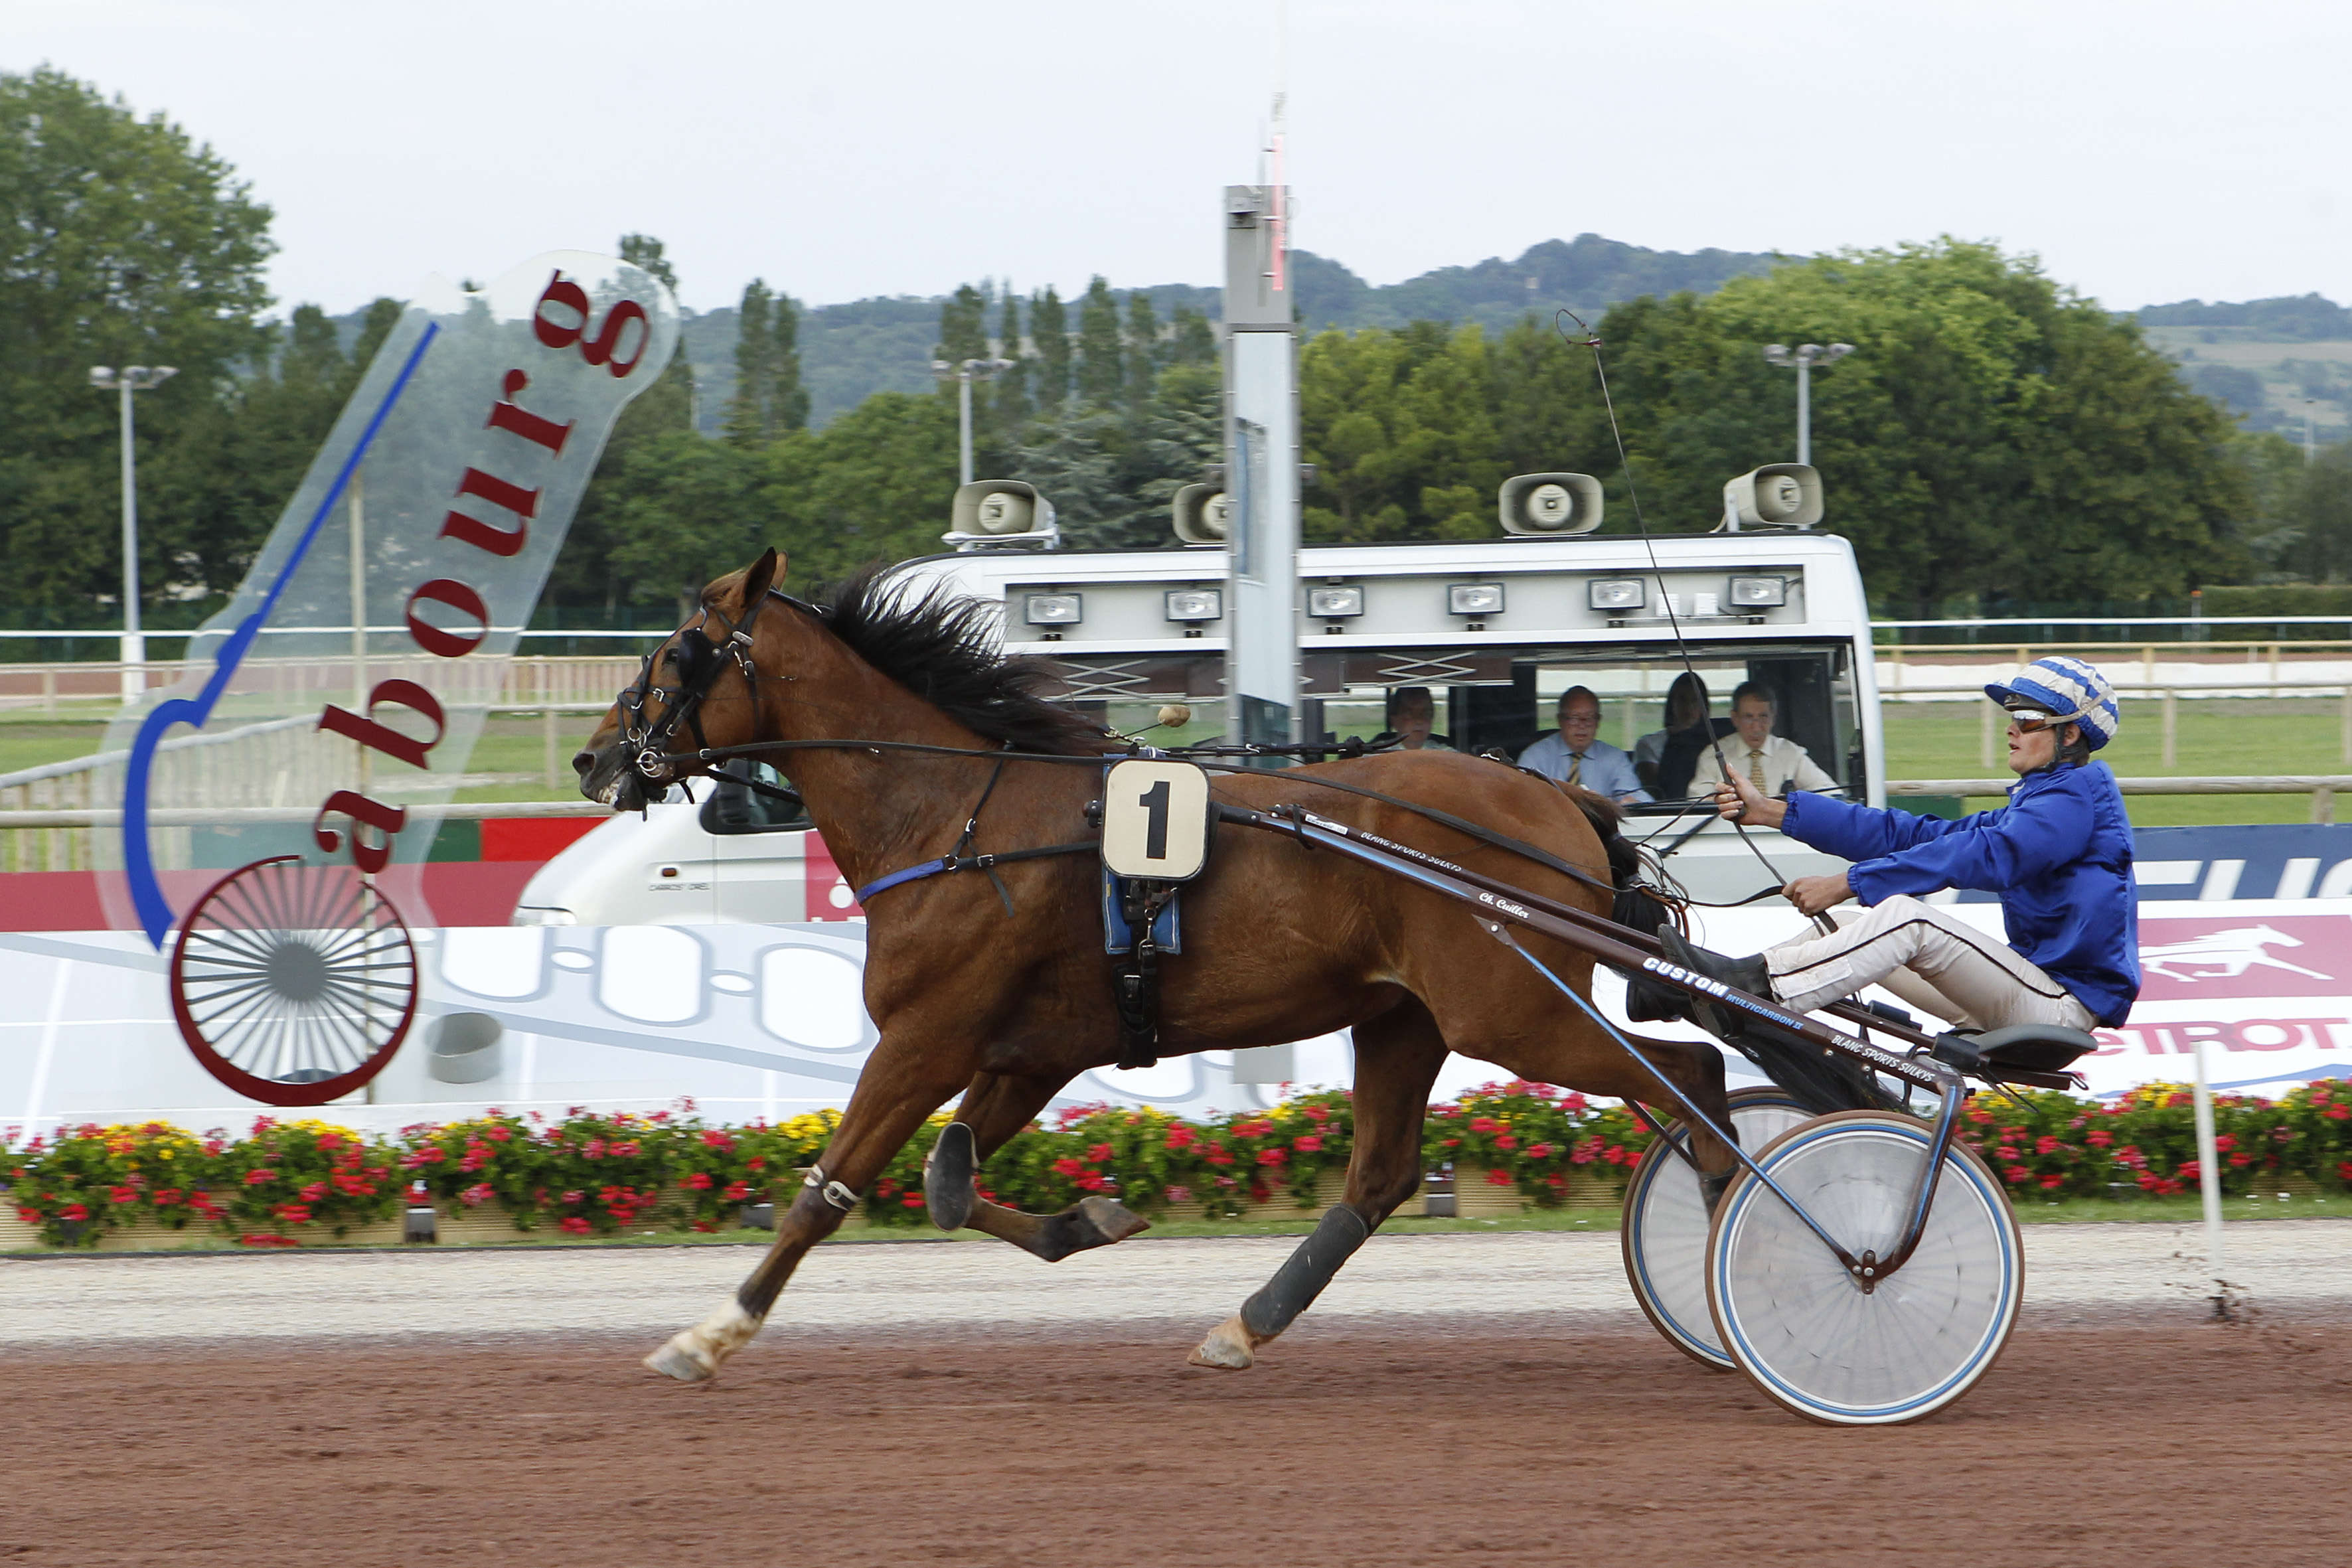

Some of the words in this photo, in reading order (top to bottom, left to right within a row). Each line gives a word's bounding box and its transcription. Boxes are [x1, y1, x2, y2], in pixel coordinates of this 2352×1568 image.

[1139, 781, 1170, 860] 1
[1479, 892, 1494, 905] Ch.
[1496, 900, 1529, 919] Cuiller
[1642, 957, 1730, 998] CUSTOM
[1831, 1035, 1863, 1054] BLANC
[1861, 1048, 1901, 1067] SPORTS
[1898, 1062, 1936, 1082] SULKYS
